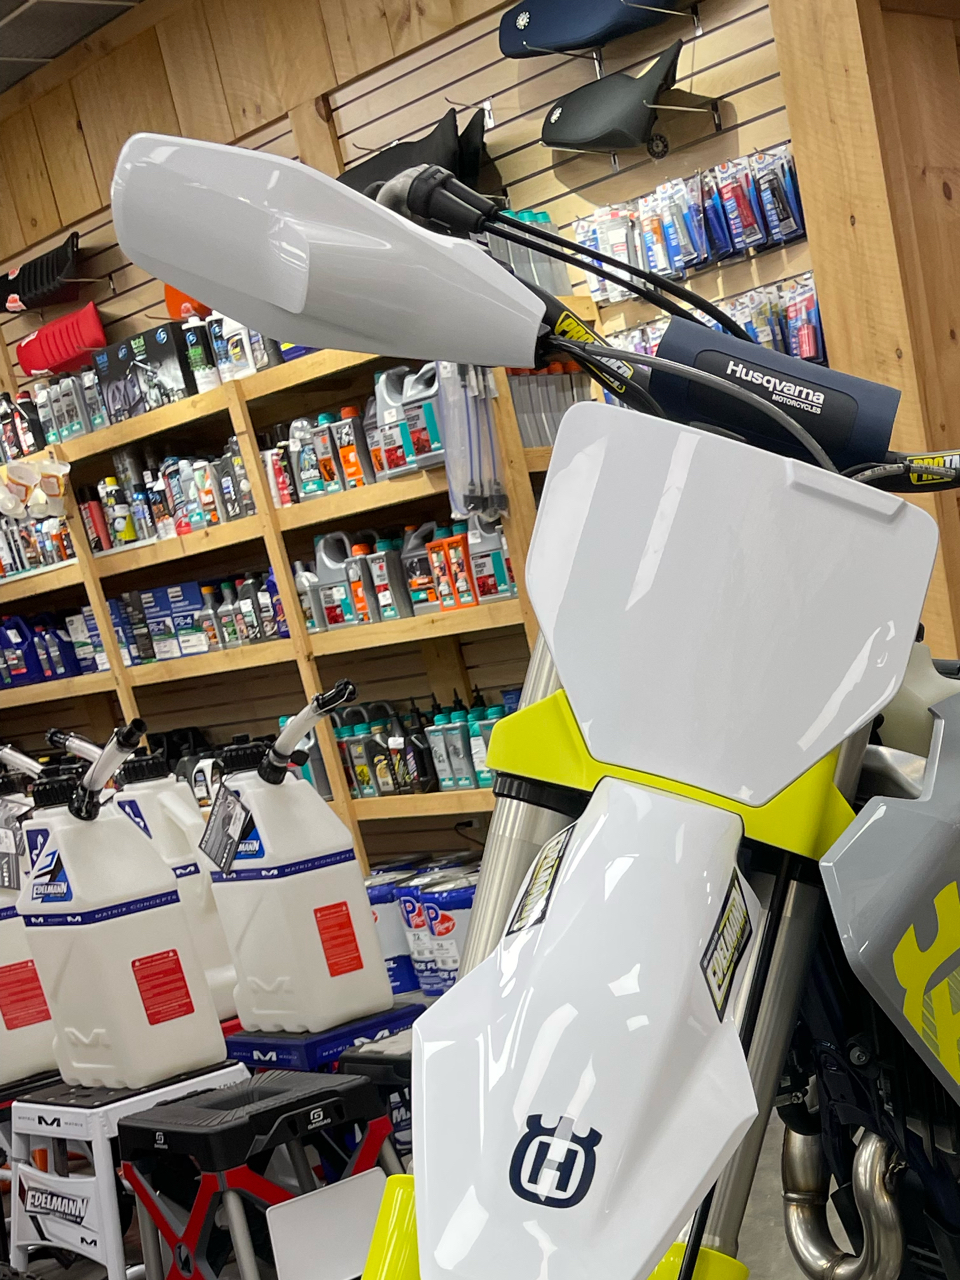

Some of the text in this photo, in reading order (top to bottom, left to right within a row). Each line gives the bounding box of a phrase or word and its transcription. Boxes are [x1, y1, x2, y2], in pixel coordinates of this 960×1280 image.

[726, 360, 825, 405] Husqvarna
[771, 393, 822, 415] MOTORCYCLES
[285, 862, 313, 873] MATRIX
[315, 852, 354, 866] CONCEPTS
[33, 881, 68, 898] EDELMANN
[95, 908, 127, 919] MATRIX
[130, 894, 178, 911] CONCEPTS
[323, 1044, 350, 1057] MATRIX
[26, 1189, 88, 1218] EDELMANN
